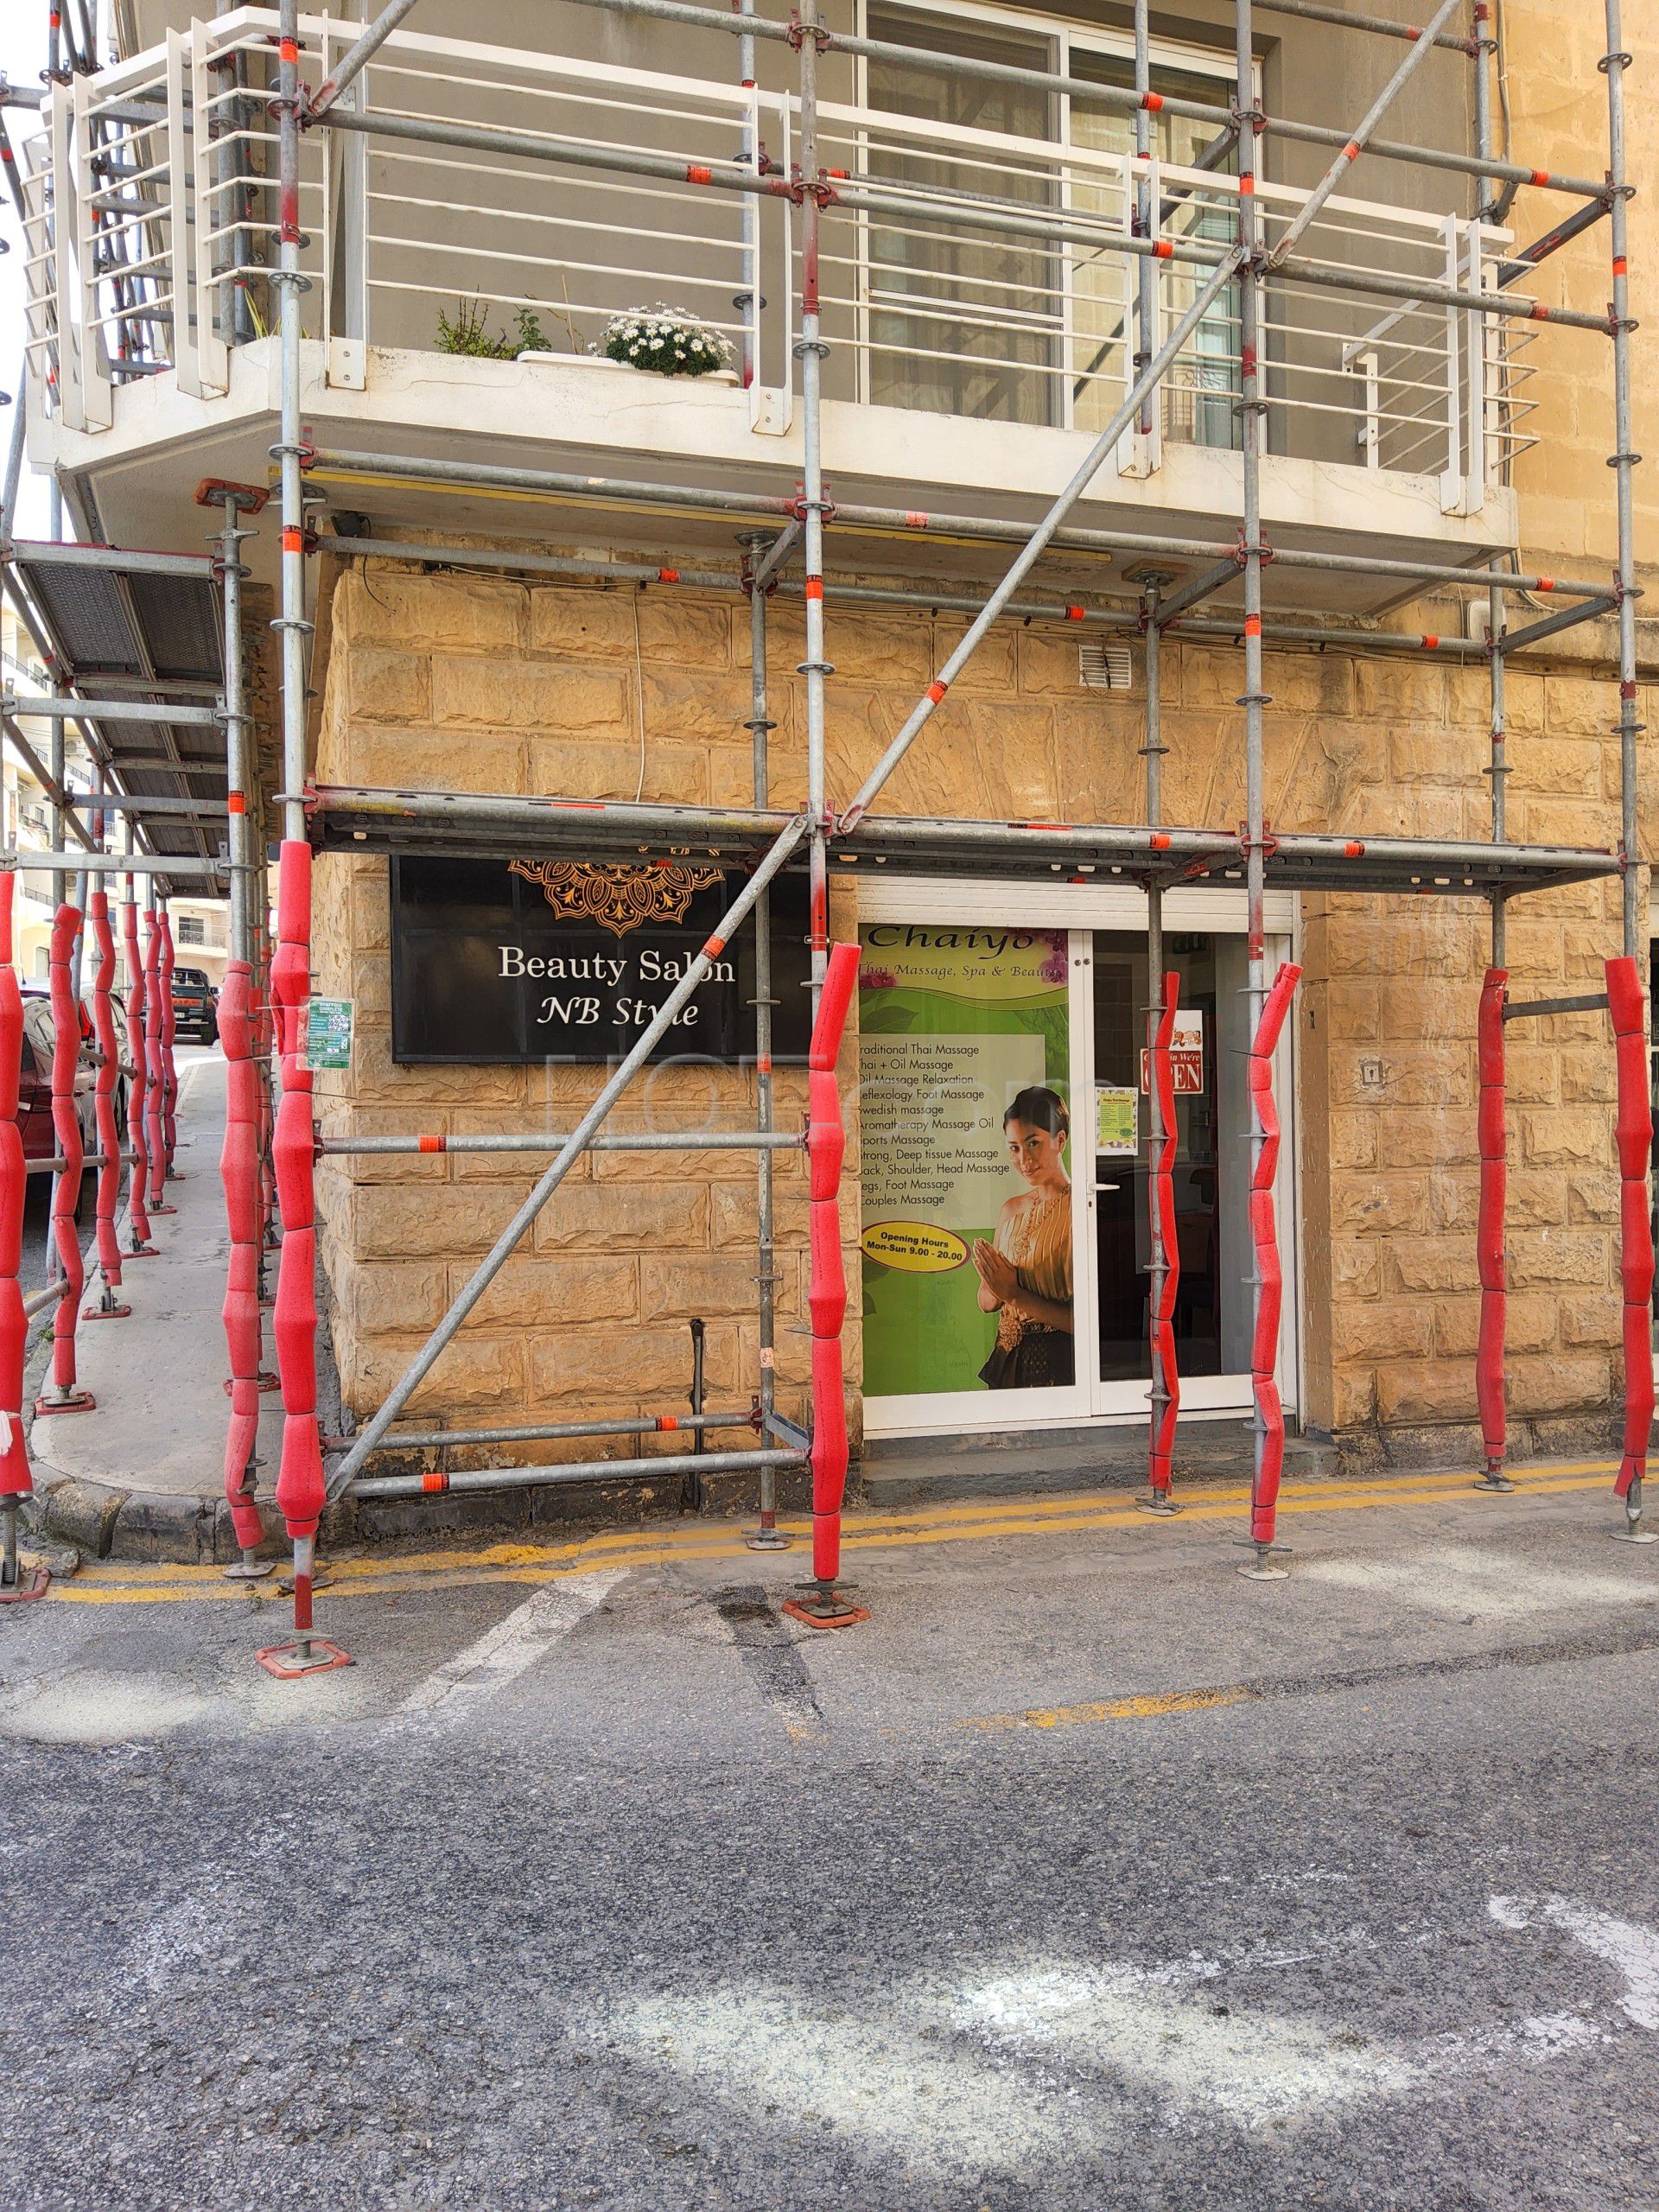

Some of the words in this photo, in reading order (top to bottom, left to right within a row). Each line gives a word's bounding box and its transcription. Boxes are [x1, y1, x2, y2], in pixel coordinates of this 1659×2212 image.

[868, 926, 1033, 960] Chaiyo
[498, 946, 628, 986] Beauty
[858, 962, 888, 975] Thai
[894, 964, 957, 981] Massage,
[962, 965, 985, 982] Spa
[992, 966, 1006, 976] &
[537, 996, 601, 1025] NB
[612, 997, 699, 1026] Ste
[860, 1042, 907, 1054] raditional
[911, 1043, 932, 1054] Thai
[936, 1045, 979, 1058] Massage
[1180, 1052, 1200, 1062] We're
[859, 1058, 876, 1070] hai
[890, 1058, 906, 1070] Oil
[909, 1058, 953, 1072] Massage
[874, 1074, 919, 1087] Massage
[922, 1074, 974, 1085] Relaxation
[1145, 1064, 1200, 1089] EN
[860, 1088, 912, 1103] eflexology
[917, 1089, 938, 1099] Foot
[941, 1090, 984, 1103] Massage
[900, 1106, 944, 1117] massage
[932, 1119, 976, 1131] Massage
[978, 1117, 994, 1128] Oil
[861, 1135, 888, 1147] ports
[891, 1134, 936, 1147] Massage
[896, 1149, 922, 1162] Deep
[925, 1148, 952, 1160] tissue
[955, 1149, 999, 1162] Massage
[887, 1163, 933, 1176] Shoulder,
[937, 1162, 963, 1173] Head
[966, 1163, 1010, 1176] Massage
[861, 1182, 882, 1193] egs,
[886, 1179, 907, 1190] Foot
[910, 1179, 955, 1192] Massage
[900, 1194, 945, 1207] Massage
[880, 1231, 919, 1245] Opening
[922, 1237, 950, 1249] Hours
[867, 1240, 906, 1254] Mon-Sun
[909, 1247, 930, 1256] 9.00
[937, 1250, 963, 1261] 20.00
